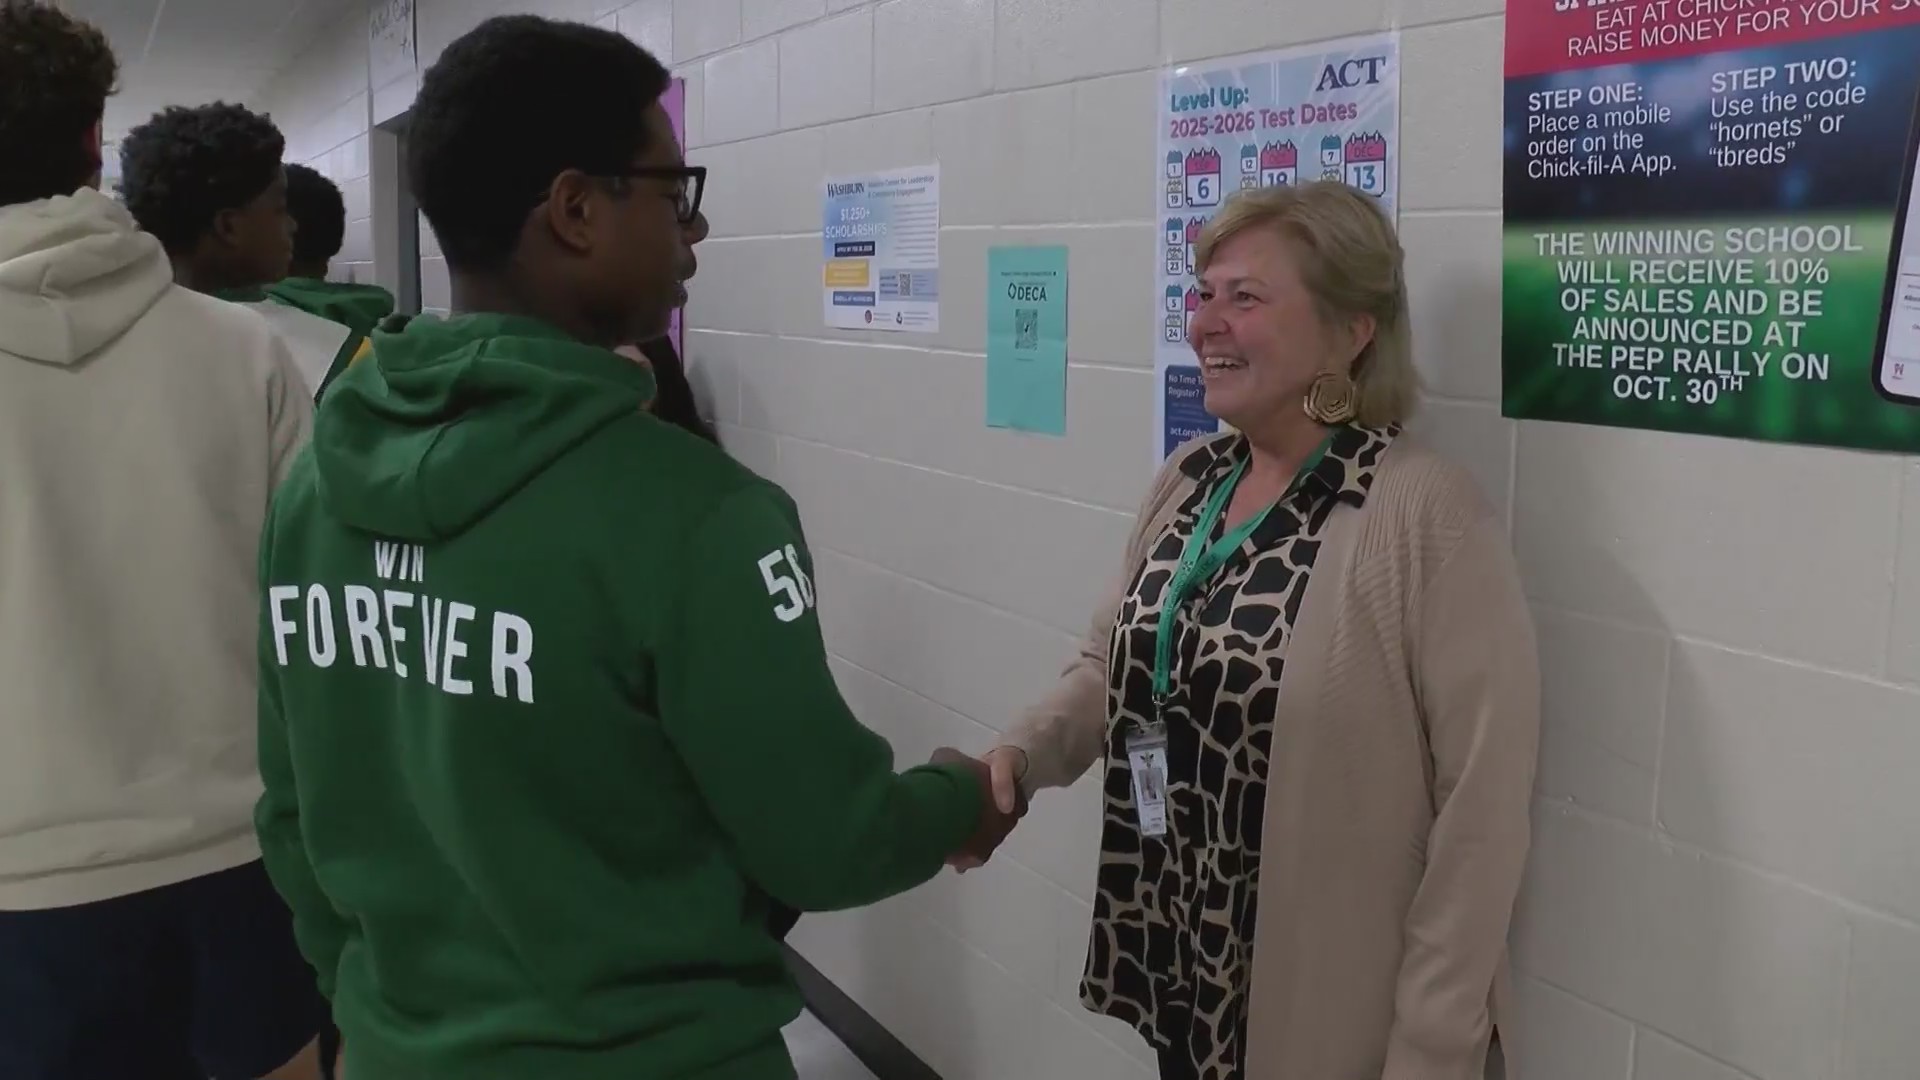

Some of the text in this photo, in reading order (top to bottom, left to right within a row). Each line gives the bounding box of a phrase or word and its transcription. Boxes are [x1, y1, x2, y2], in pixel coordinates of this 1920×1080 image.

[1568, 30, 1633, 57] RAISE
[1640, 16, 1729, 48] MONEY
[1736, 7, 1790, 35] FOR
[1800, 0, 1880, 25] YOUR
[1596, 6, 1638, 30] EAT
[1641, 1, 1671, 23] AT
[1315, 56, 1386, 92] ACT
[1711, 57, 1857, 93] STEP TWO:
[1171, 86, 1250, 112] Level Up:
[1528, 82, 1643, 112] STEP ONE:
[1711, 81, 1866, 118] Use the code
[1170, 102, 1358, 139] 2025-2026 Test Dates
[1528, 103, 1671, 134] Place a mobile
[1819, 114, 1844, 134] or
[1327, 151, 1335, 161] 7
[1528, 129, 1644, 157] order on the
[1245, 159, 1253, 169] 12
[1353, 165, 1376, 190] 13
[1528, 153, 1677, 179] Chick-fil-A App.
[1197, 177, 1210, 199] 6
[1533, 224, 1863, 256] THE WINNING SCHOOL
[1557, 258, 1829, 284] WILL RECEIVE 10%
[1017, 286, 1047, 301] DECA
[1561, 288, 1823, 316] OF SALES AND BE
[1572, 316, 1806, 348] ANNOUNCED AT
[1552, 343, 1829, 380] THE PEP RALLY ON
[1180, 374, 1197, 385] Time
[1613, 374, 1677, 402] OCT.
[375, 541, 424, 583] WIN
[758, 543, 815, 622] 56
[269, 583, 535, 704] FOREVER
